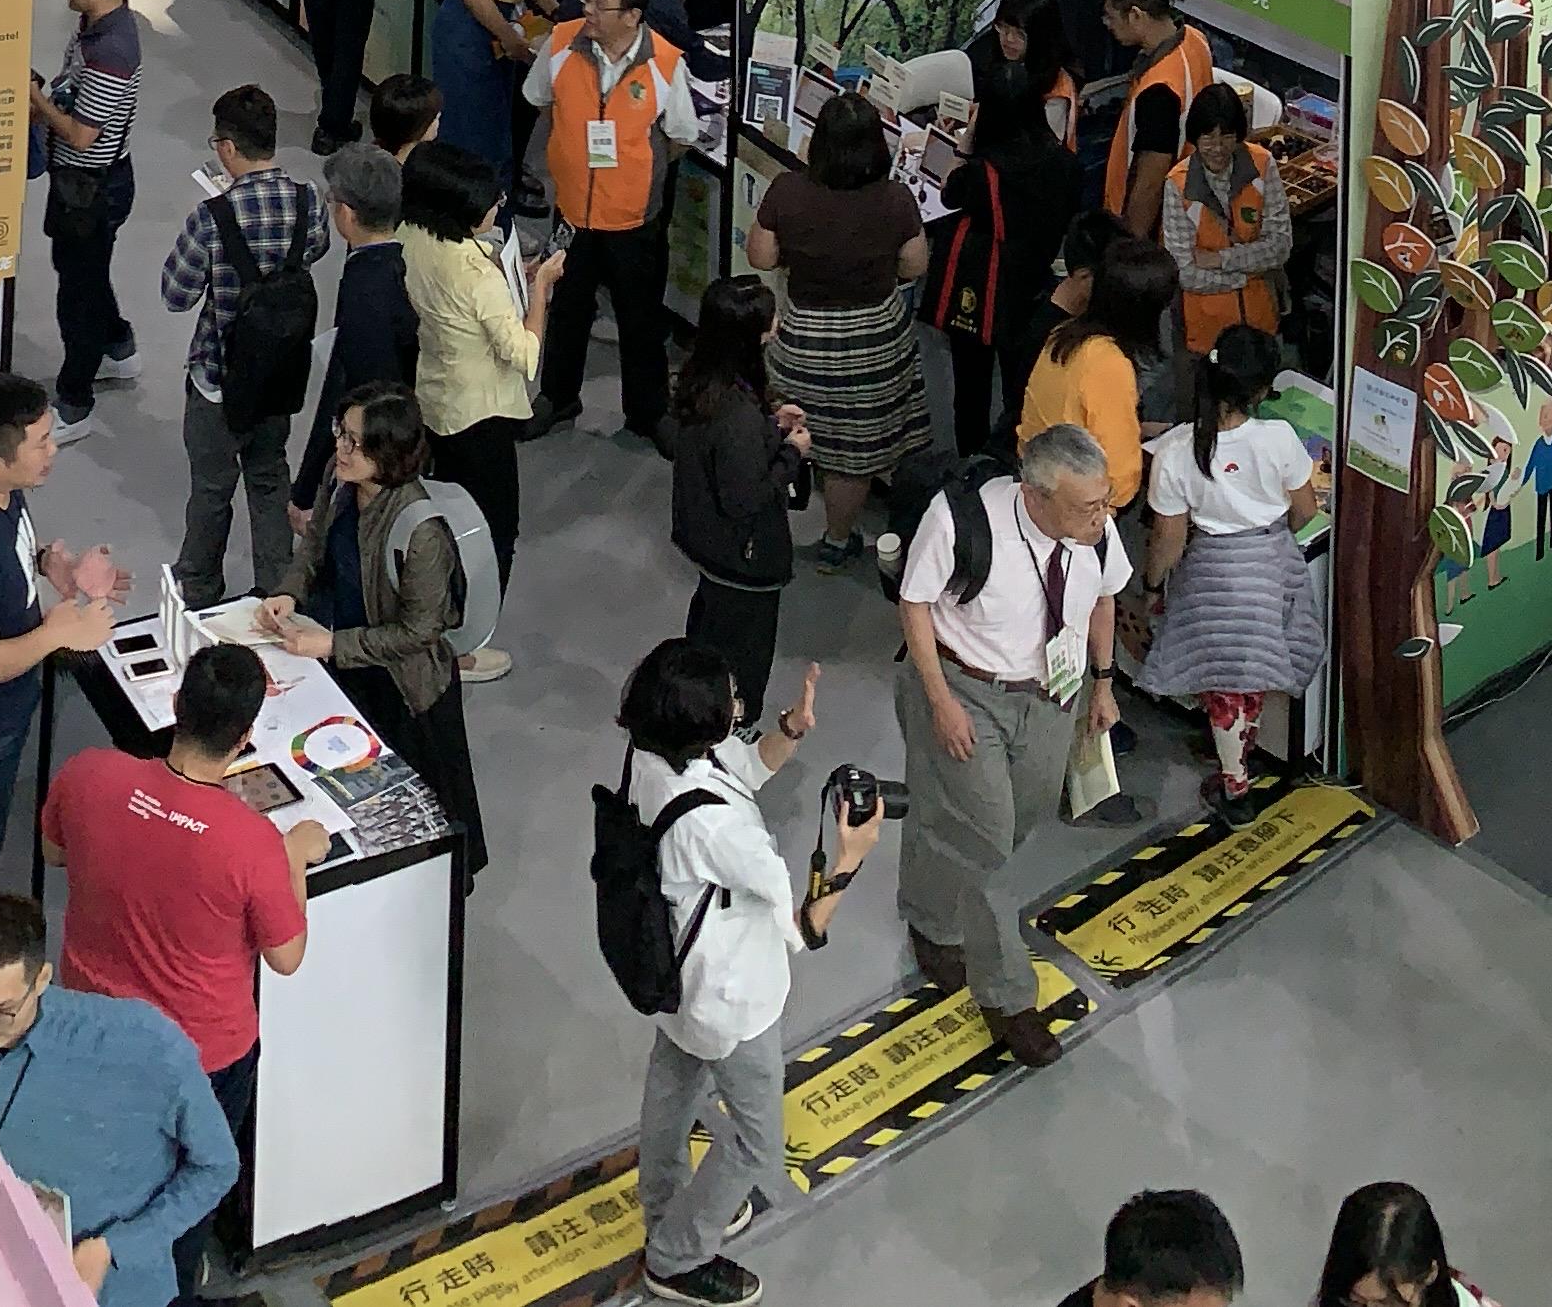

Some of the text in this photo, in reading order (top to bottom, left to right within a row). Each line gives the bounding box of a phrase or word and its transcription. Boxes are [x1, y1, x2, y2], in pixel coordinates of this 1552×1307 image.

[1107, 807, 1296, 936] 行走時 請注意腳下
[800, 1059, 882, 1117] 行走時
[820, 1097, 862, 1130] Please
[862, 1086, 887, 1107] pay
[887, 1052, 939, 1090] attention
[398, 1250, 497, 1307] 行走時
[522, 1246, 587, 1283] attention
